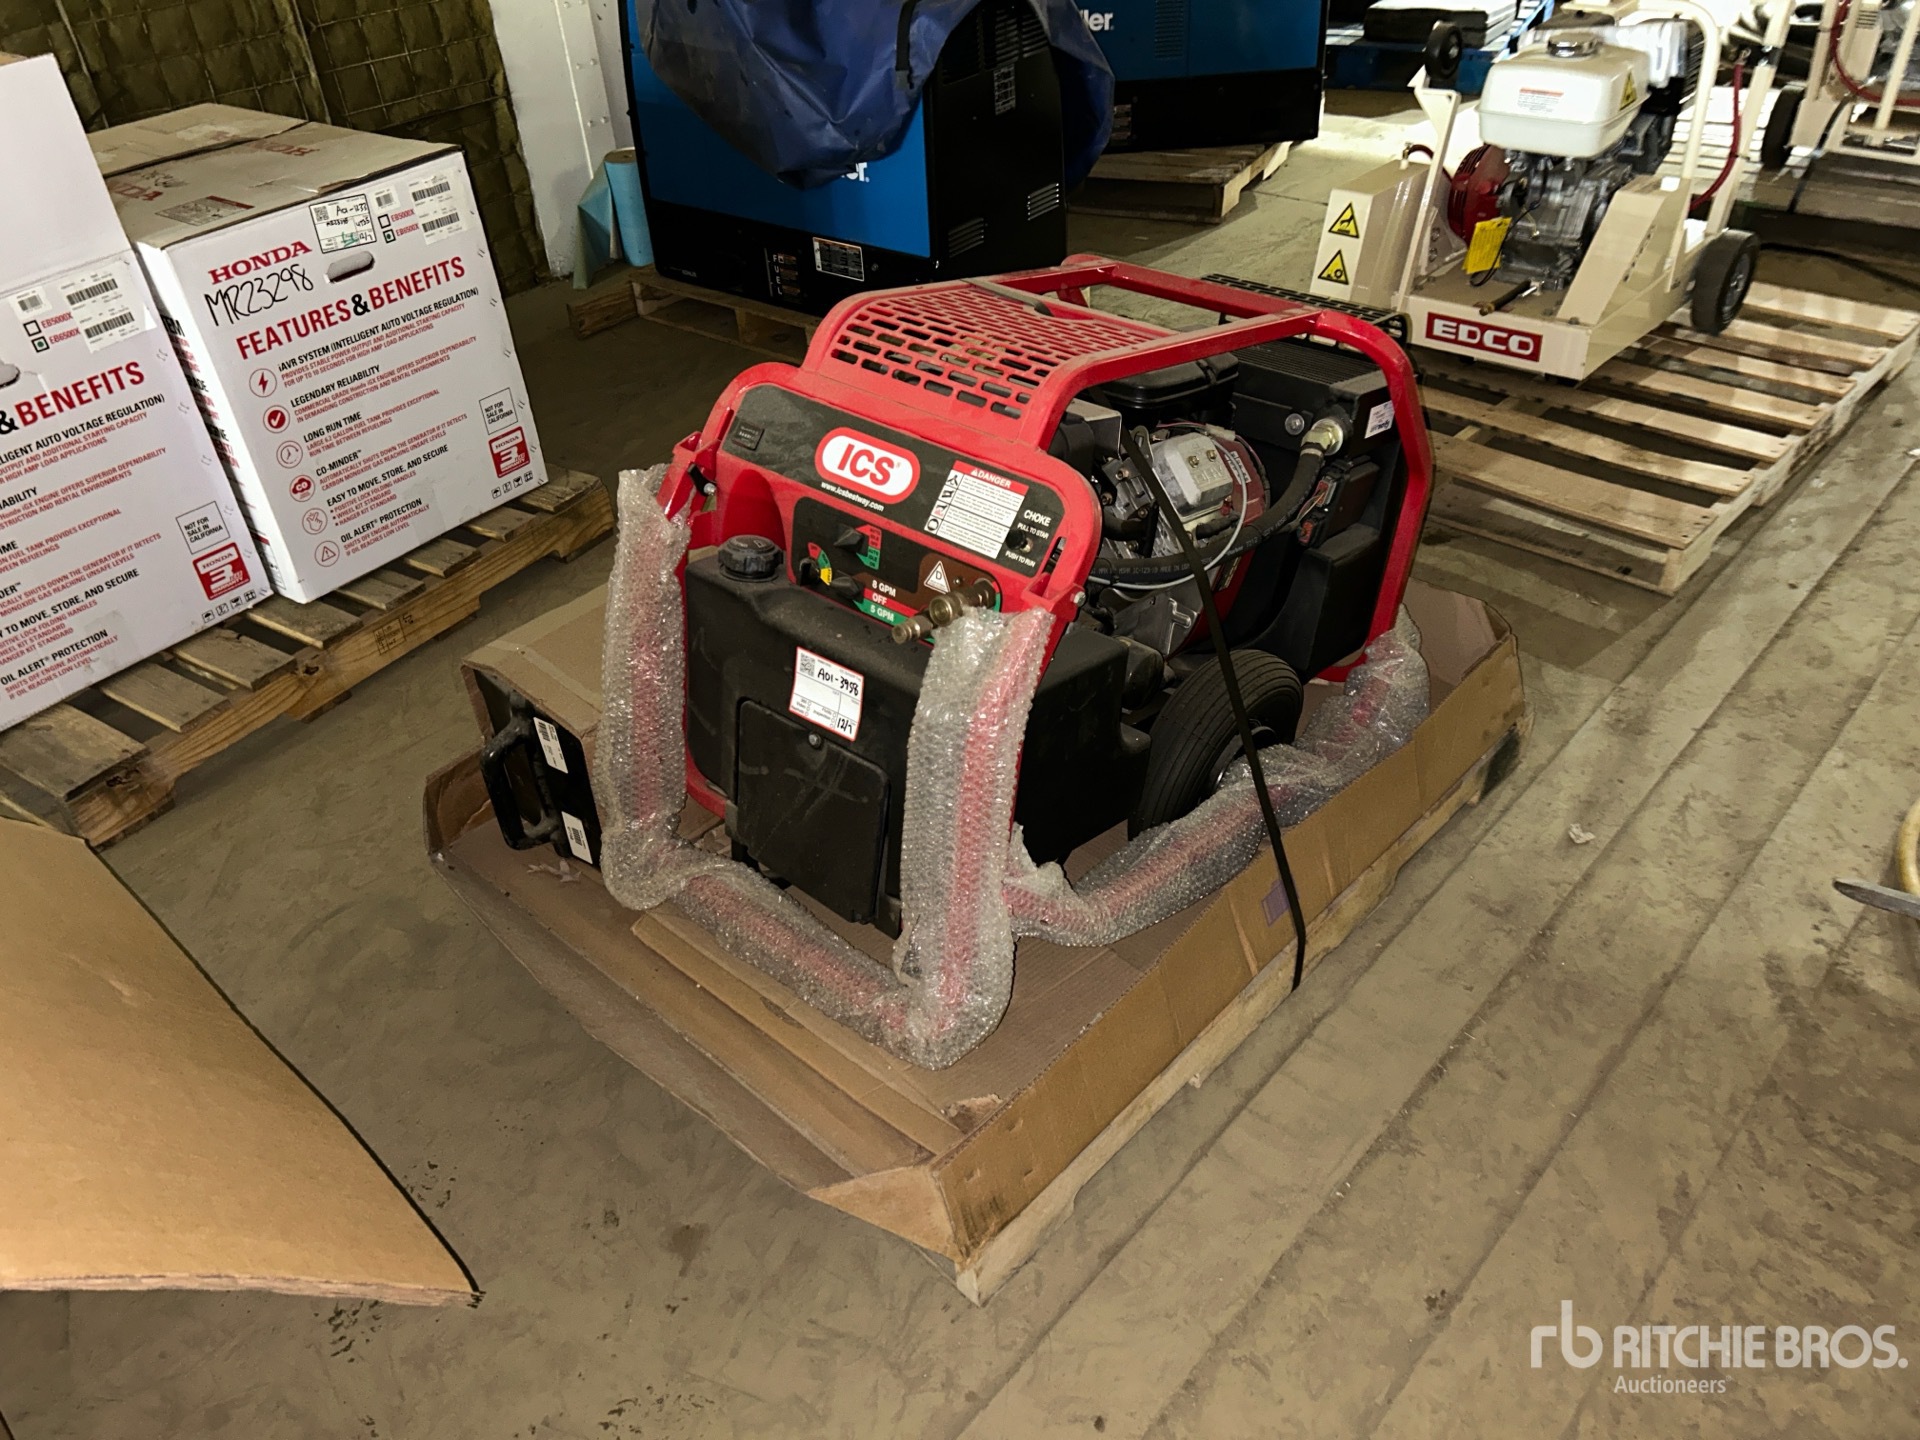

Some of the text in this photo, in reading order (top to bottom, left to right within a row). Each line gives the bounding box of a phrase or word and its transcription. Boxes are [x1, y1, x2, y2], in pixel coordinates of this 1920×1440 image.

[208, 240, 312, 284] HONDA
[204, 263, 314, 326] MR23298
[41, 312, 73, 328] EB5000X
[298, 344, 330, 362] SYSTEM
[330, 325, 379, 351] (INTELLIGENT
[381, 317, 400, 330] AUTO
[401, 305, 432, 322] VOLTAGE
[434, 287, 478, 311] REGULATION)
[49, 328, 80, 344] EB6500X
[1433, 318, 1535, 355] EDCO
[290, 365, 380, 407] LEGENDARY RELIABILITY
[34, 393, 166, 449] AUTO VOLTAGE REGULATION)
[488, 410, 512, 424] CALIFORNIA
[304, 413, 360, 442] LONG RUN TIME
[496, 435, 518, 448] HONDA
[838, 444, 894, 486] ICS
[327, 492, 346, 505] EASY
[358, 476, 381, 493] MOVE,
[382, 464, 406, 482] STORE,
[407, 458, 421, 468] AND
[423, 446, 447, 461] SECURE
[978, 470, 1012, 489] DANGER
[340, 531, 352, 542] OIL
[379, 498, 421, 523] PROTECTION
[1017, 523, 1029, 532] PULL
[1024, 510, 1052, 527] CHOKE
[187, 527, 201, 536] SALE
[190, 525, 222, 542] CALIFORNIA
[202, 552, 232, 568] HONDA
[872, 593, 887, 605] OFF
[879, 582, 896, 597] GPM
[6, 570, 138, 633] TO MOVE, STORE, AND SECURE
[871, 605, 894, 622] 5 GPM
[0, 672, 17, 684] OIL
[52, 629, 108, 660] PROTECTION
